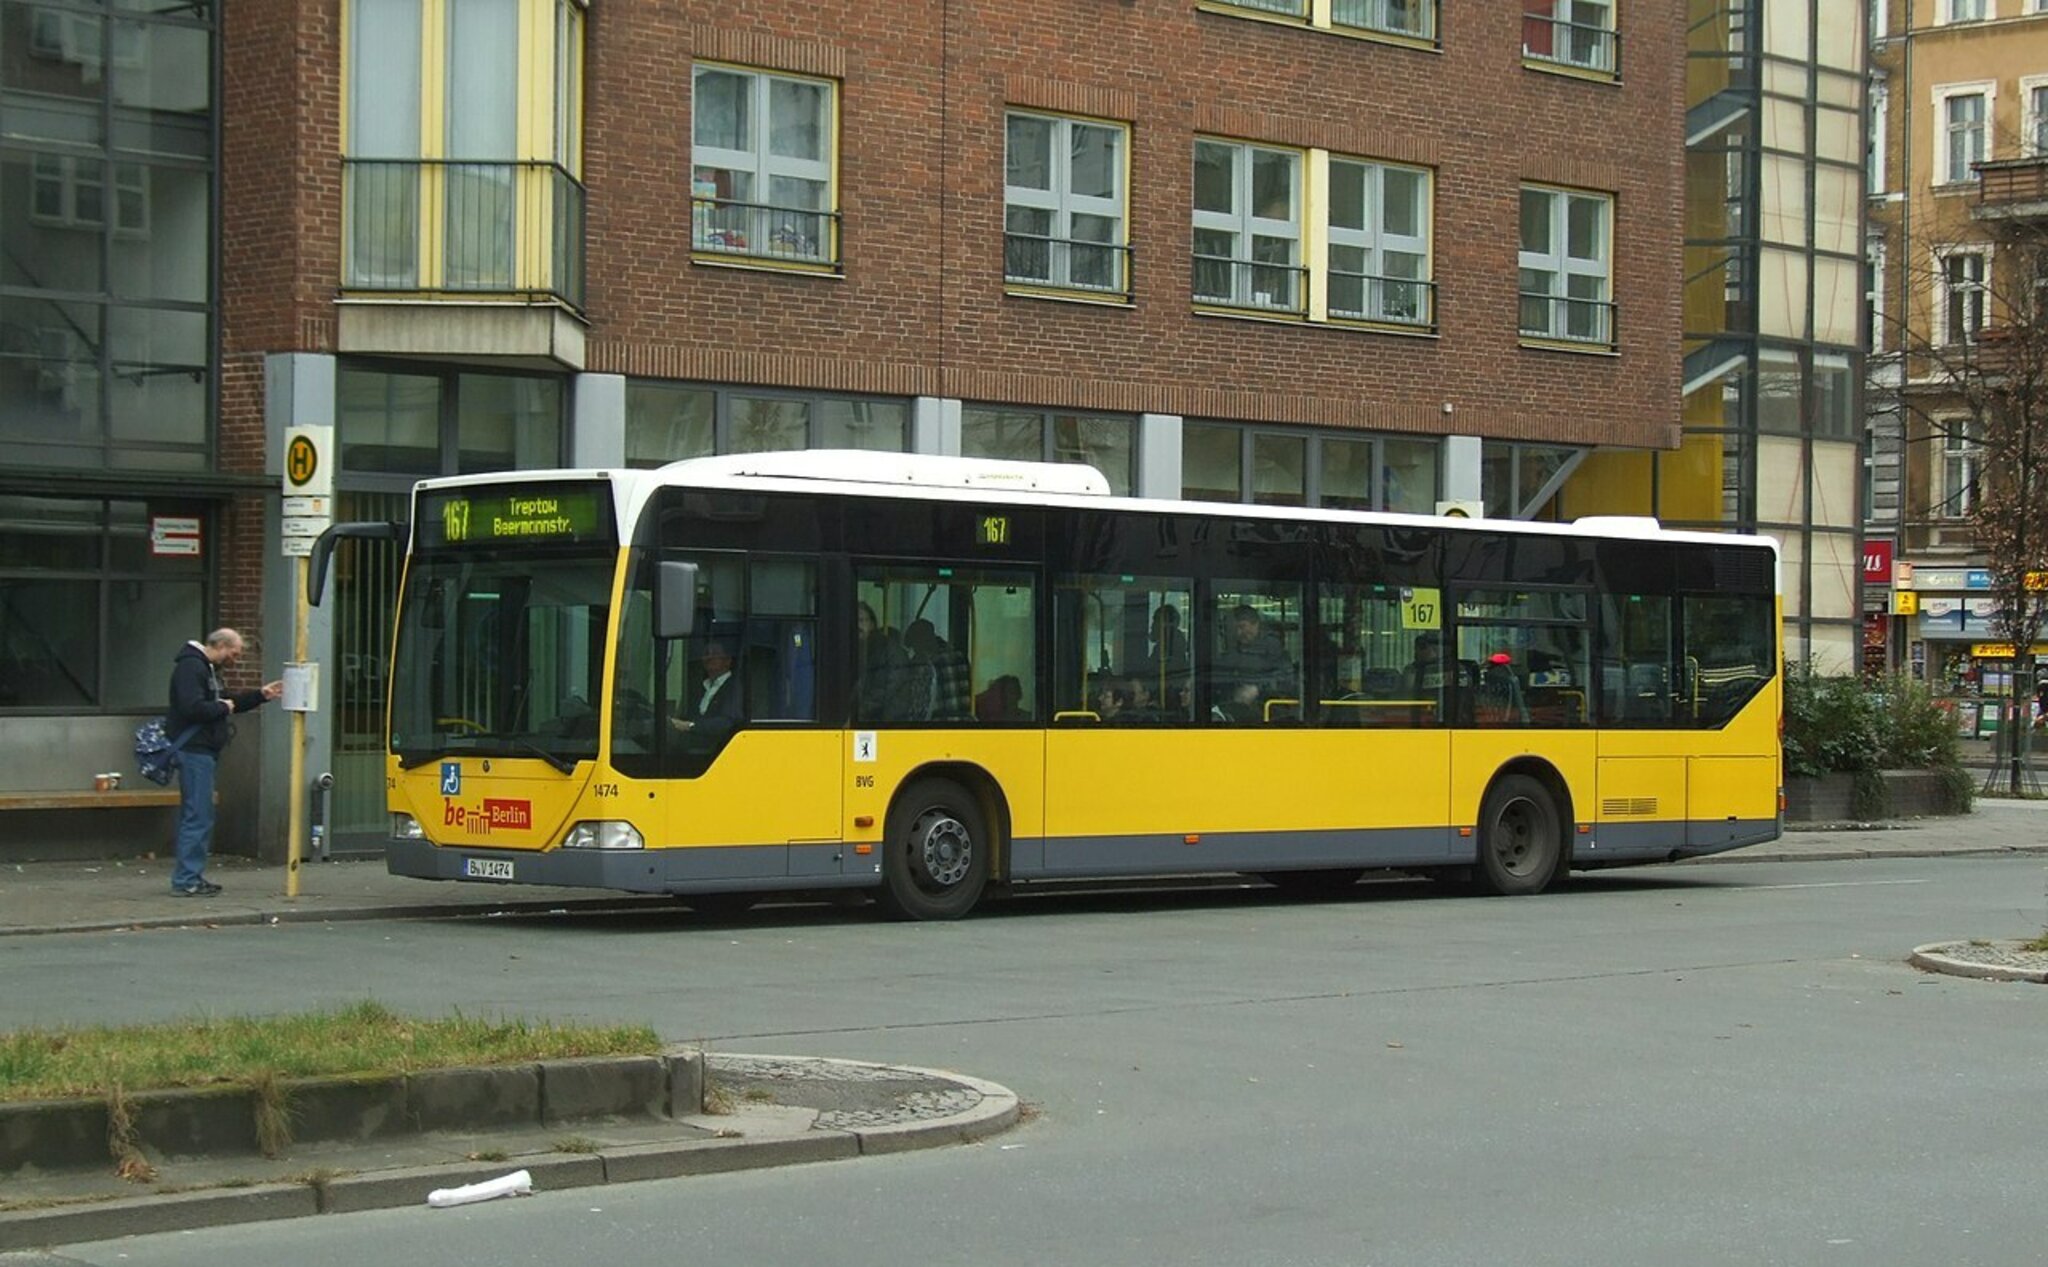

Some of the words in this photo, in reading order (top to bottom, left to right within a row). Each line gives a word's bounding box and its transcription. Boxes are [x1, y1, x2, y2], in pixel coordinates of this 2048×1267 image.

[294, 447, 307, 474] H
[510, 497, 558, 516] Treptow
[443, 500, 469, 540] 167
[493, 516, 573, 536] Beermannstr.
[983, 516, 1006, 543] 167
[1410, 603, 1434, 623] 167
[593, 783, 619, 798] 1474
[855, 775, 875, 788] BVG
[491, 805, 528, 824] Berlin
